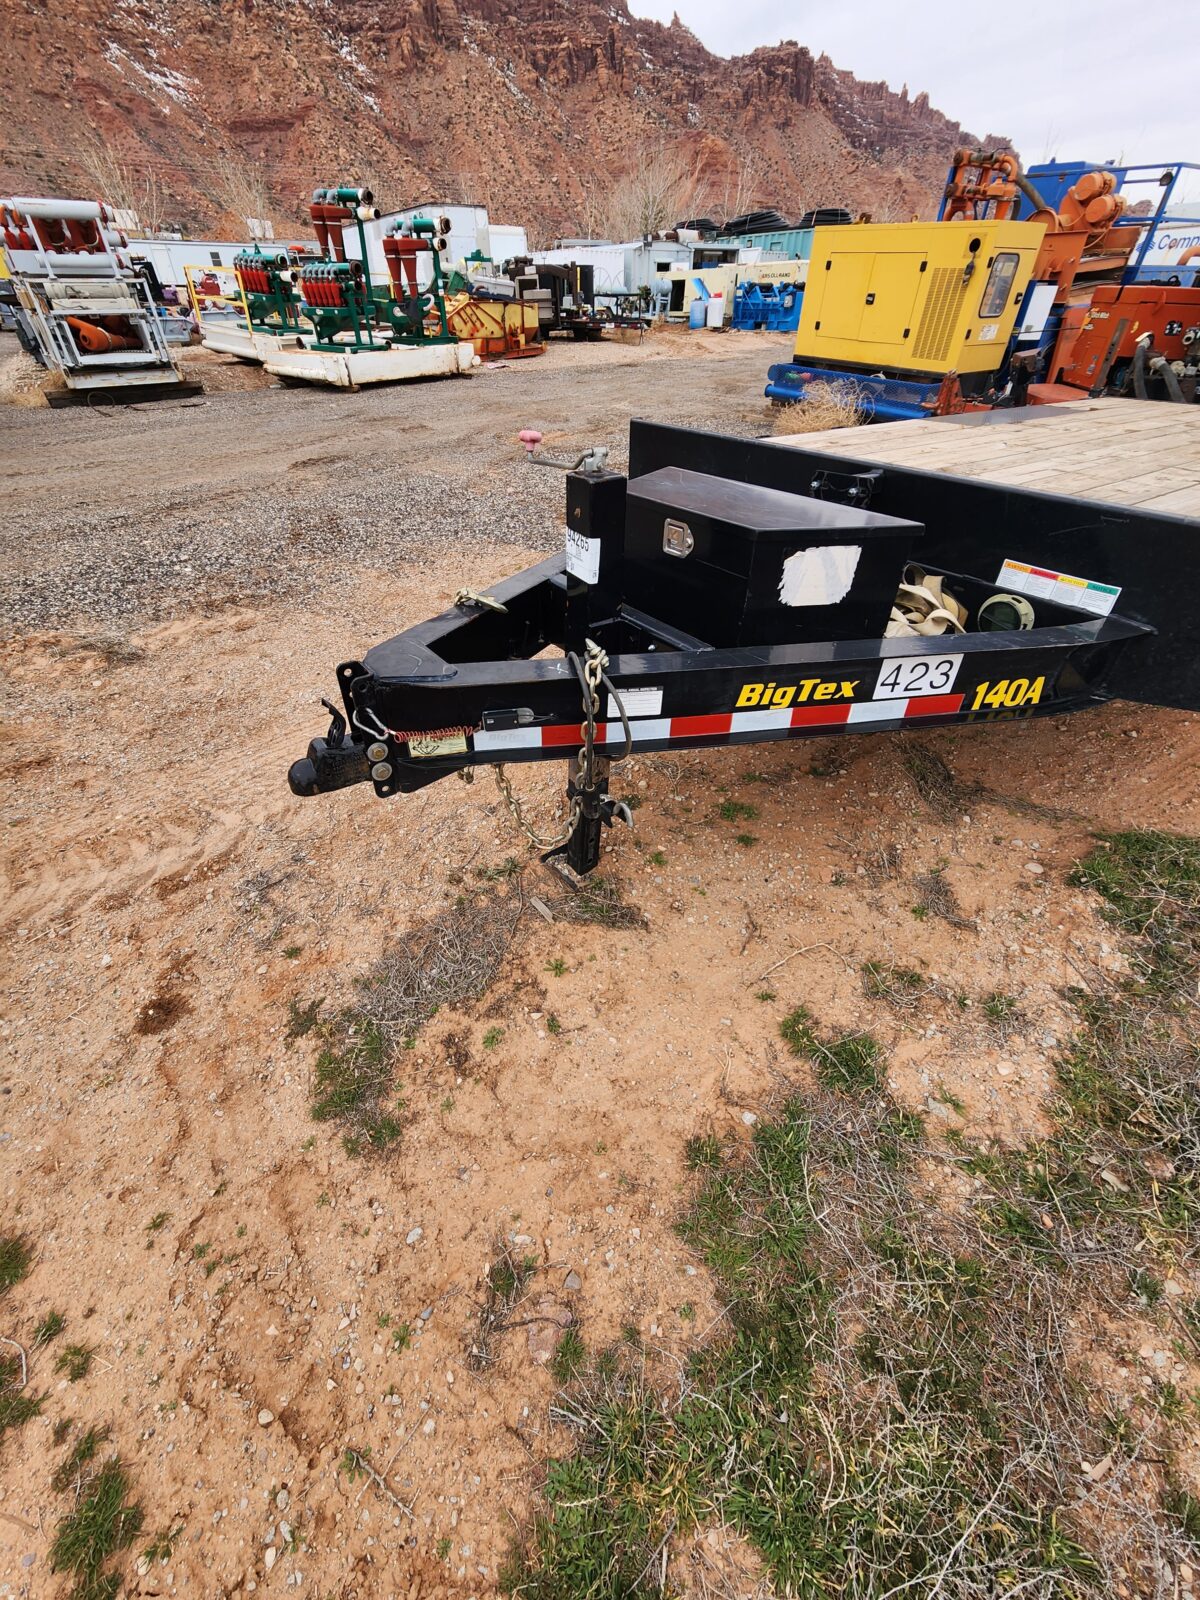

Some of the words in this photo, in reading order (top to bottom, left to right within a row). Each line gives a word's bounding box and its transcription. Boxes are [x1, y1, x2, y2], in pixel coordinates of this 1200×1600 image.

[880, 659, 955, 693] 423
[735, 678, 861, 710] BigTex
[971, 676, 1046, 711] 140A
